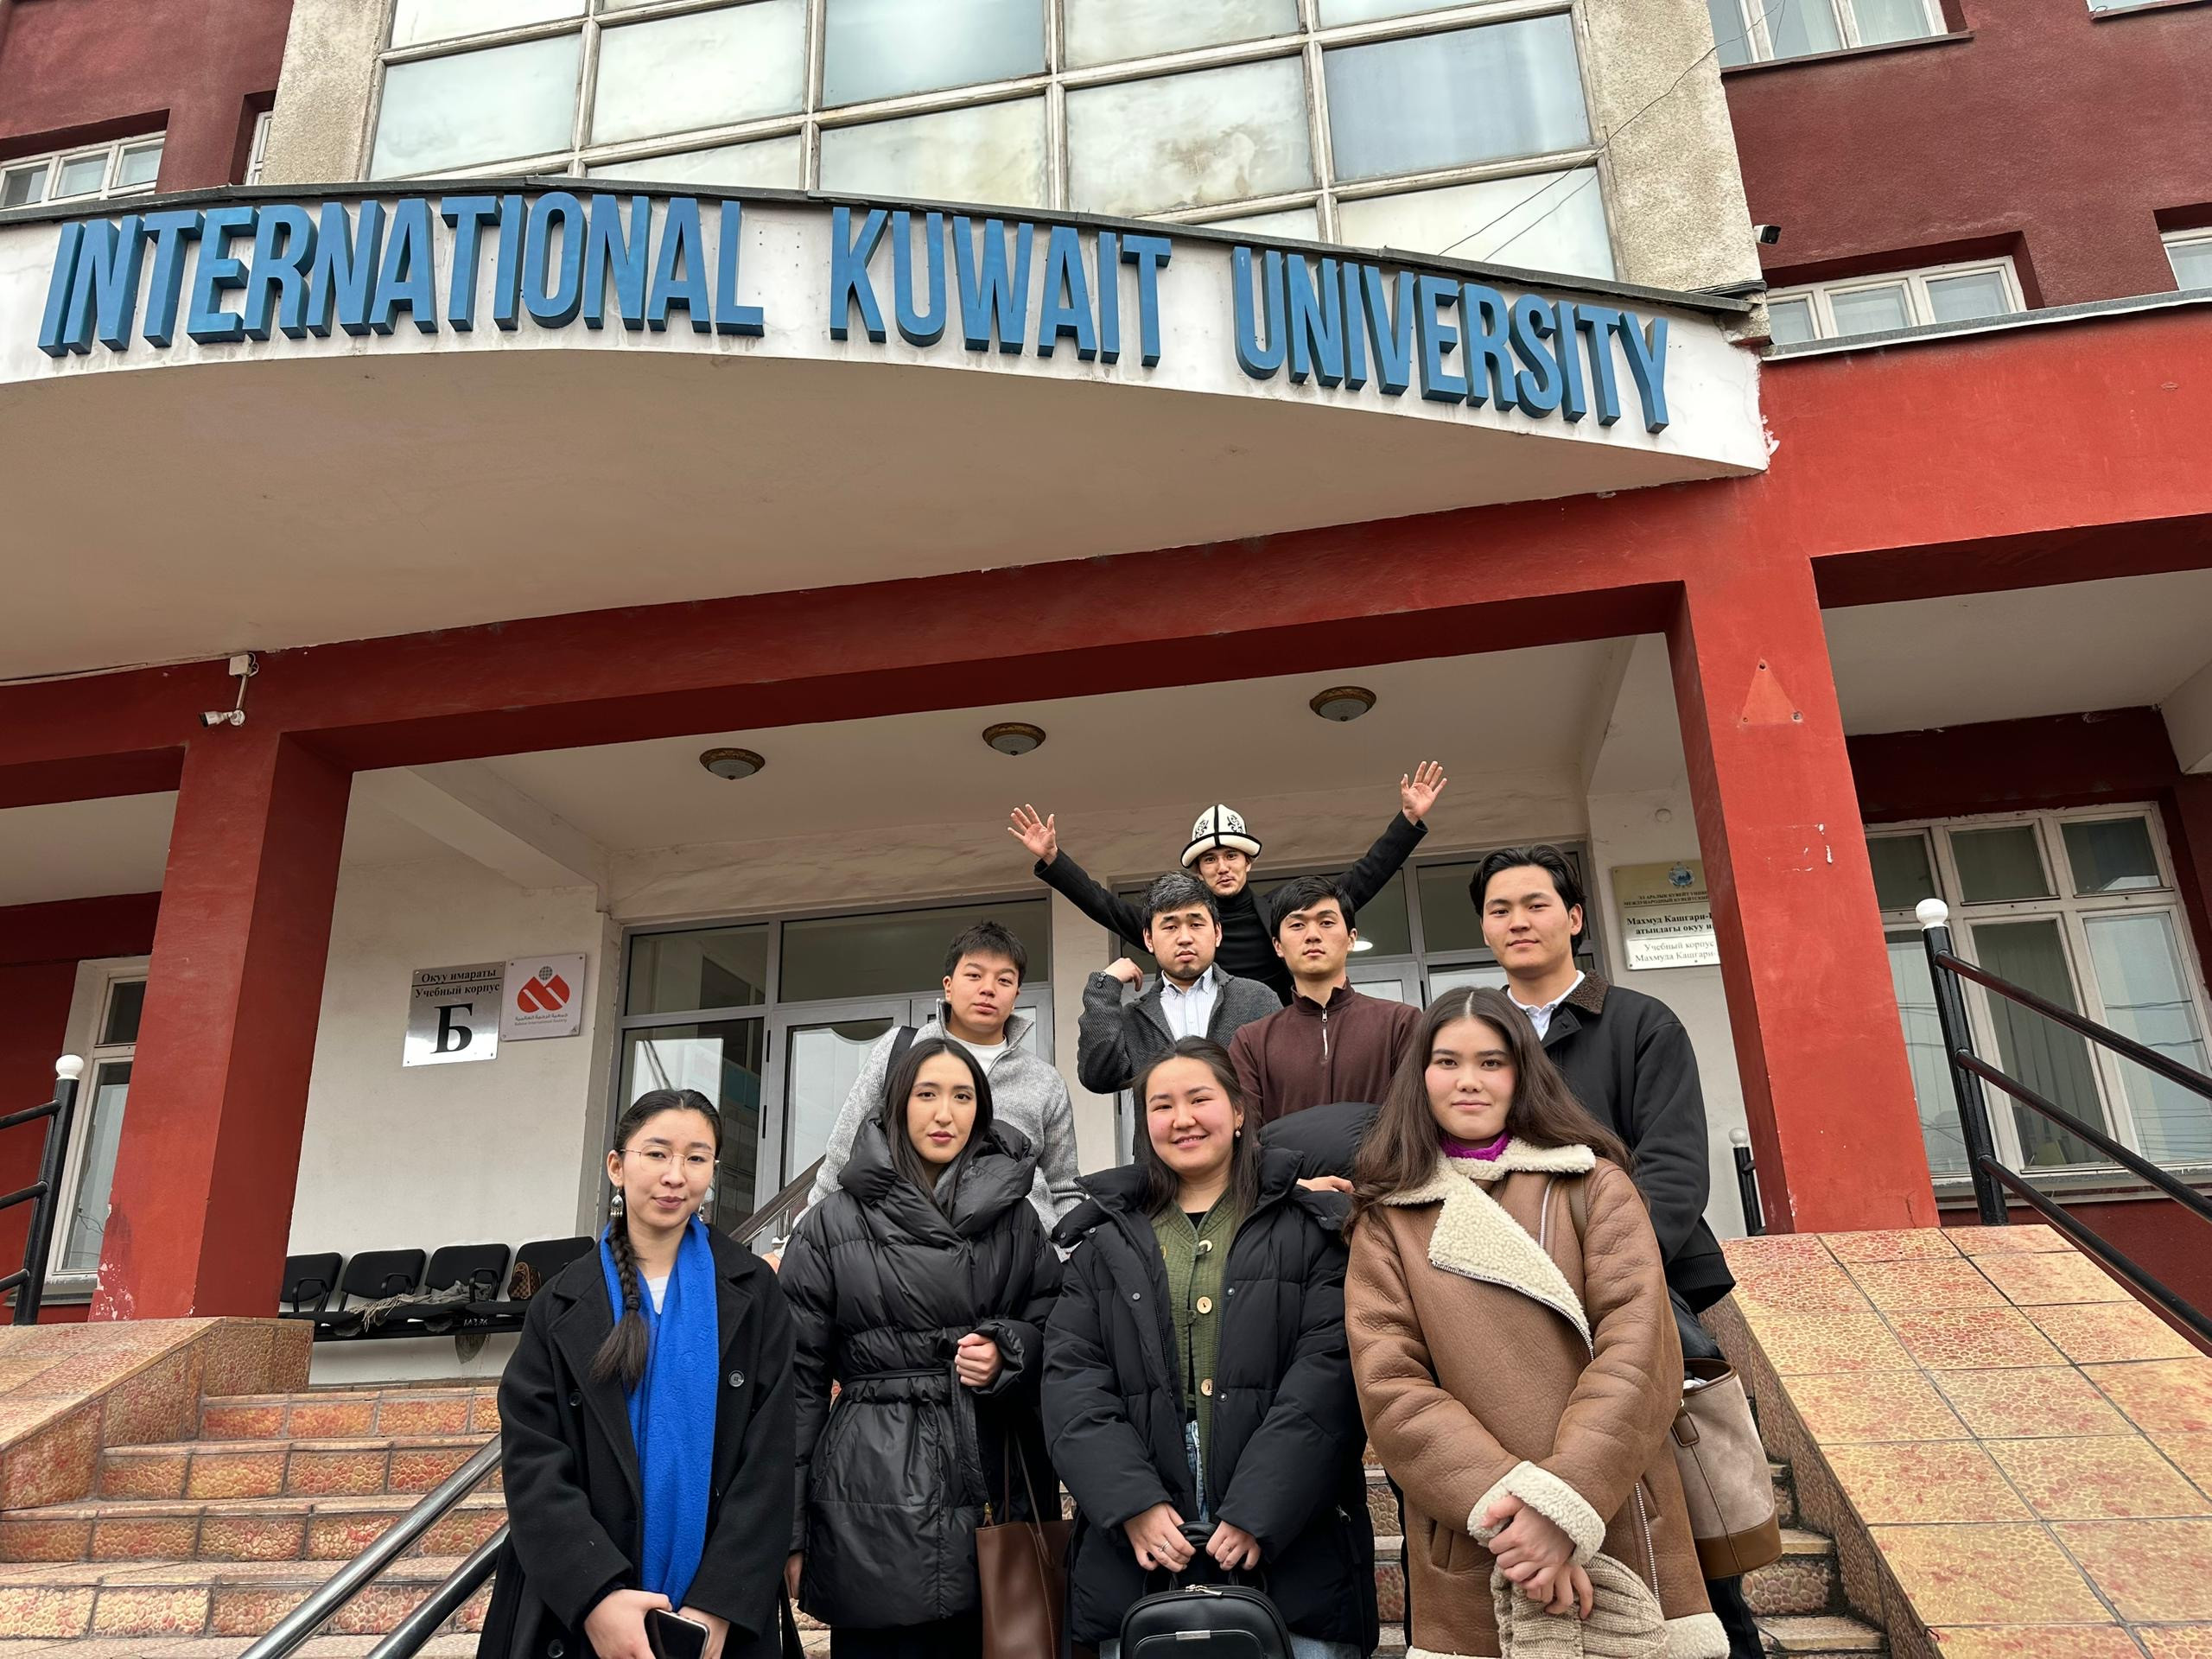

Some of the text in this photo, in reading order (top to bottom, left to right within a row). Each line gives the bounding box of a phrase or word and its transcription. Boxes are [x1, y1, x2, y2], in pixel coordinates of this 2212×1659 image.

[38, 191, 1669, 434] INTERNATIONAL KUWAIT UNIVERSITY
[1626, 916, 1662, 926] Махмуд
[1636, 925, 1681, 935] атындагы
[1683, 924, 1704, 932] окуу
[1643, 940, 1714, 951] Учебный корпус
[1635, 954, 1675, 963] Махмуда
[422, 969, 497, 984] Окуу имараты
[415, 982, 500, 998] Учебный корпус
[429, 1002, 474, 1054] Б
